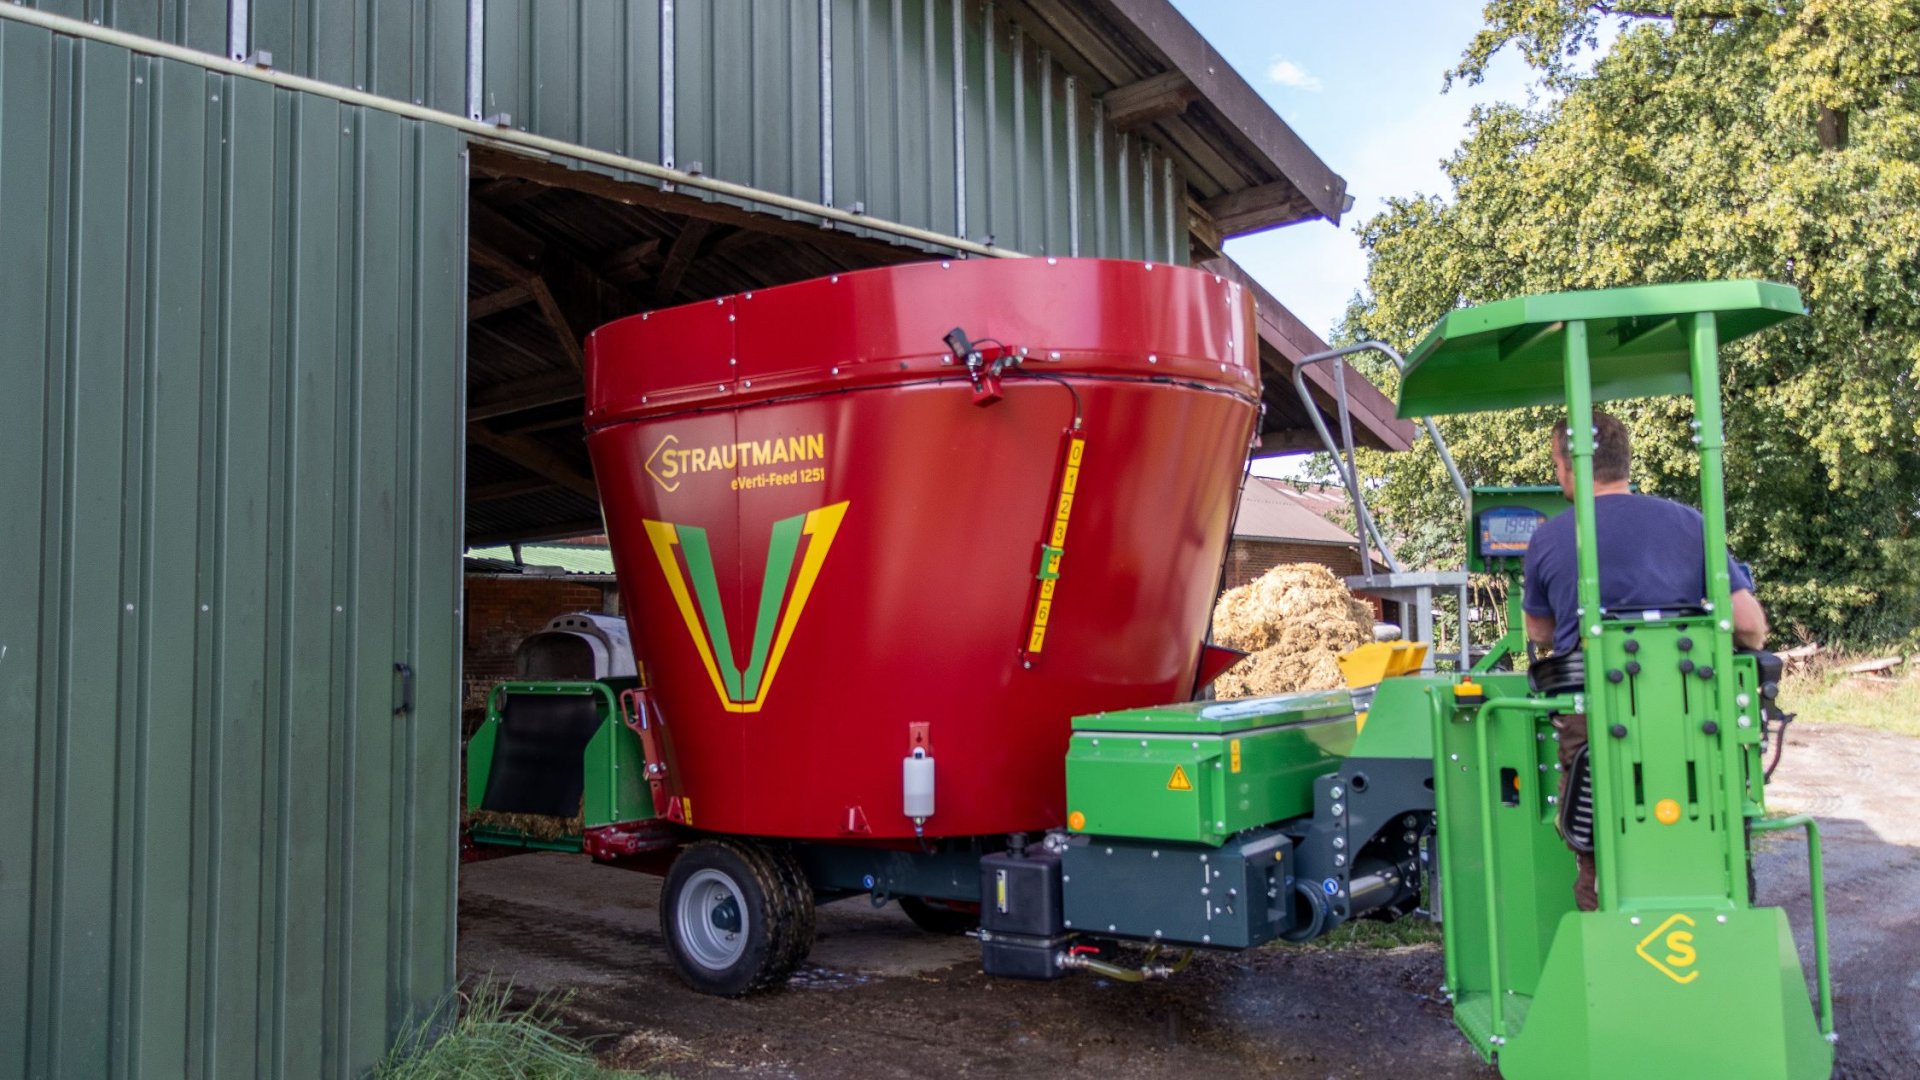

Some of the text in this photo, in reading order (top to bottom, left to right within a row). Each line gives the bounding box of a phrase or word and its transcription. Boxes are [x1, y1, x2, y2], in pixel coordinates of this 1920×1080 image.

[661, 433, 825, 479] STRAUTMANN
[1071, 446, 1081, 460] 0
[731, 467, 825, 491] eVerti-Feed 1251
[1060, 500, 1070, 514] 2
[1055, 527, 1064, 541] 3
[1044, 579, 1052, 593] 5
[1038, 606, 1048, 621] 6
[1034, 632, 1042, 646] 7
[1665, 930, 1697, 967] S
